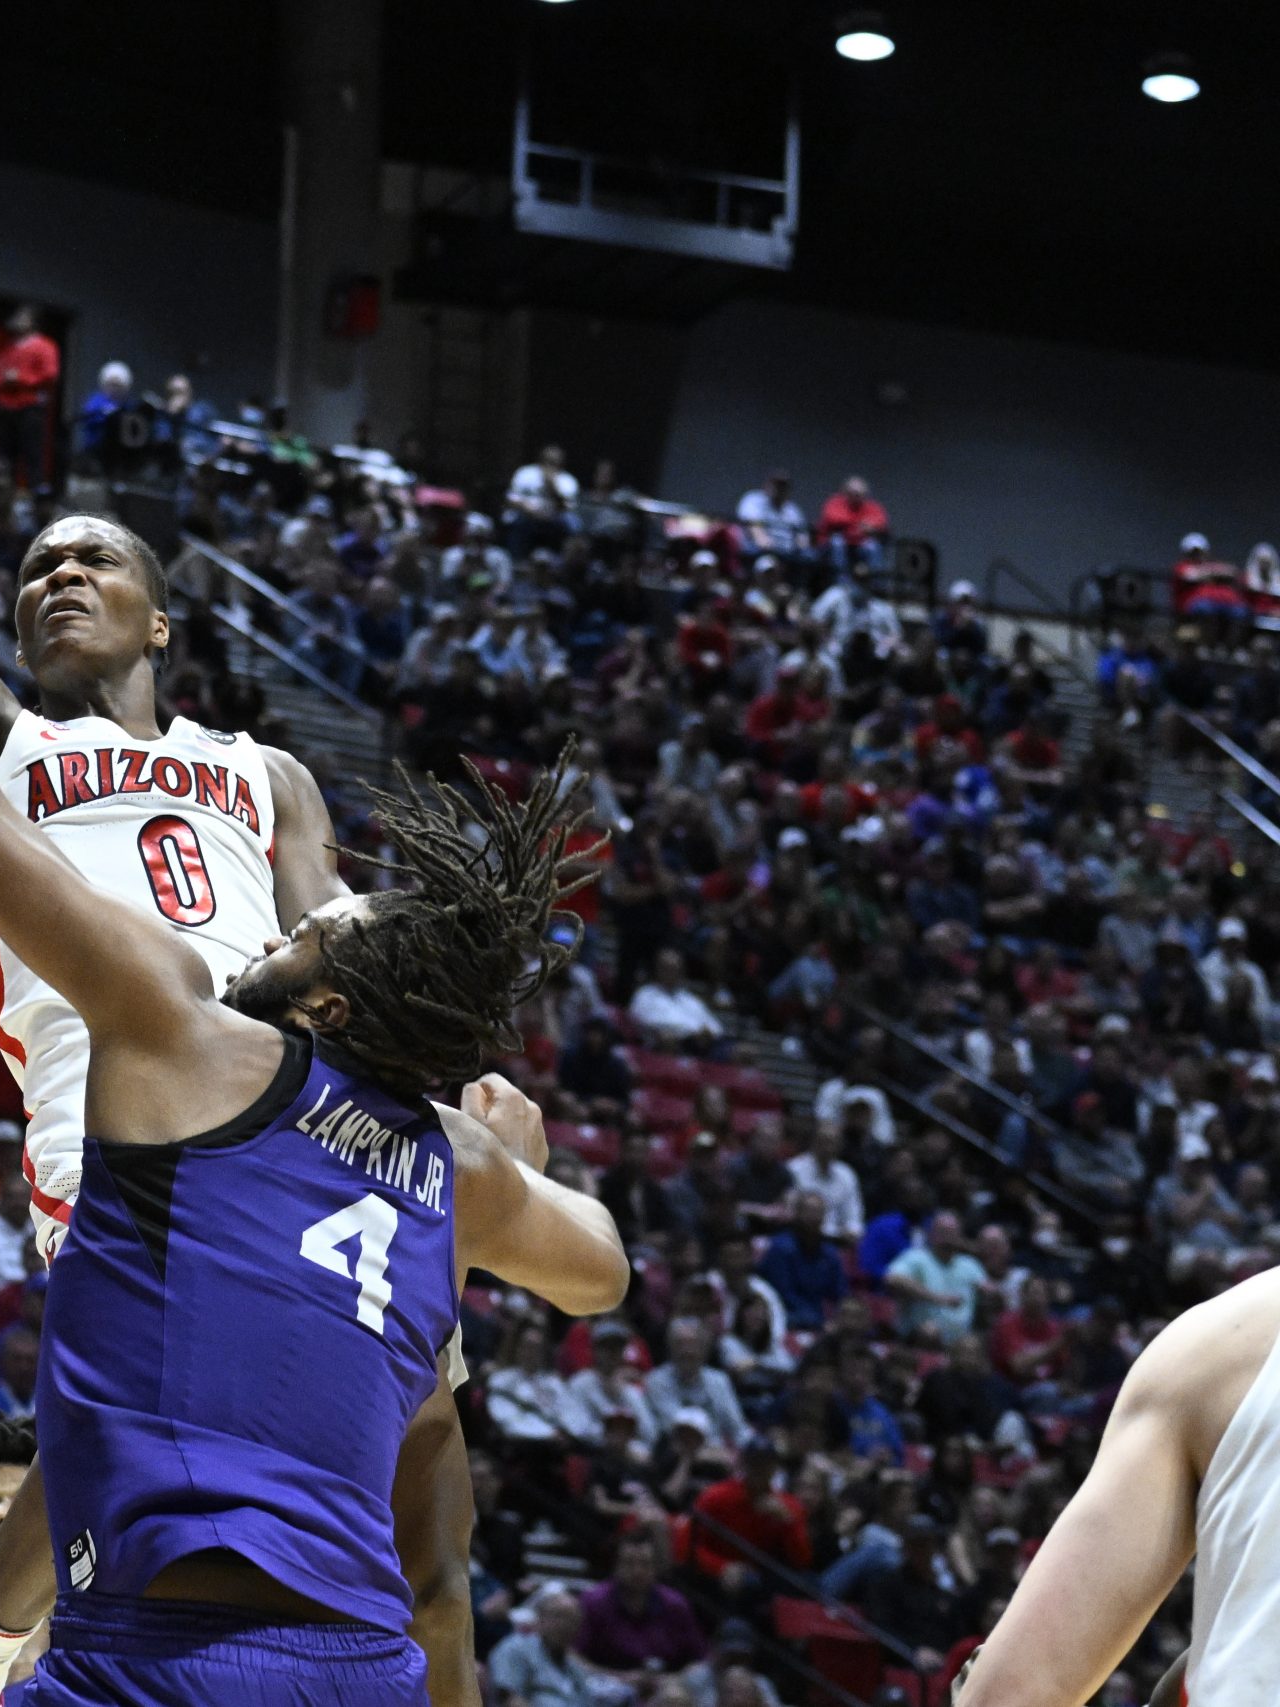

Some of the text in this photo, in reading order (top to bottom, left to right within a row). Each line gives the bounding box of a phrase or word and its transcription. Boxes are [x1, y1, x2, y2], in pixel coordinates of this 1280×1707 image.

[26, 748, 261, 836] ARIZONA
[137, 814, 217, 927] 0
[295, 1083, 446, 1216] LAMPKIN JR.
[299, 1192, 398, 1335] 4
[70, 1538, 83, 1558] 50
